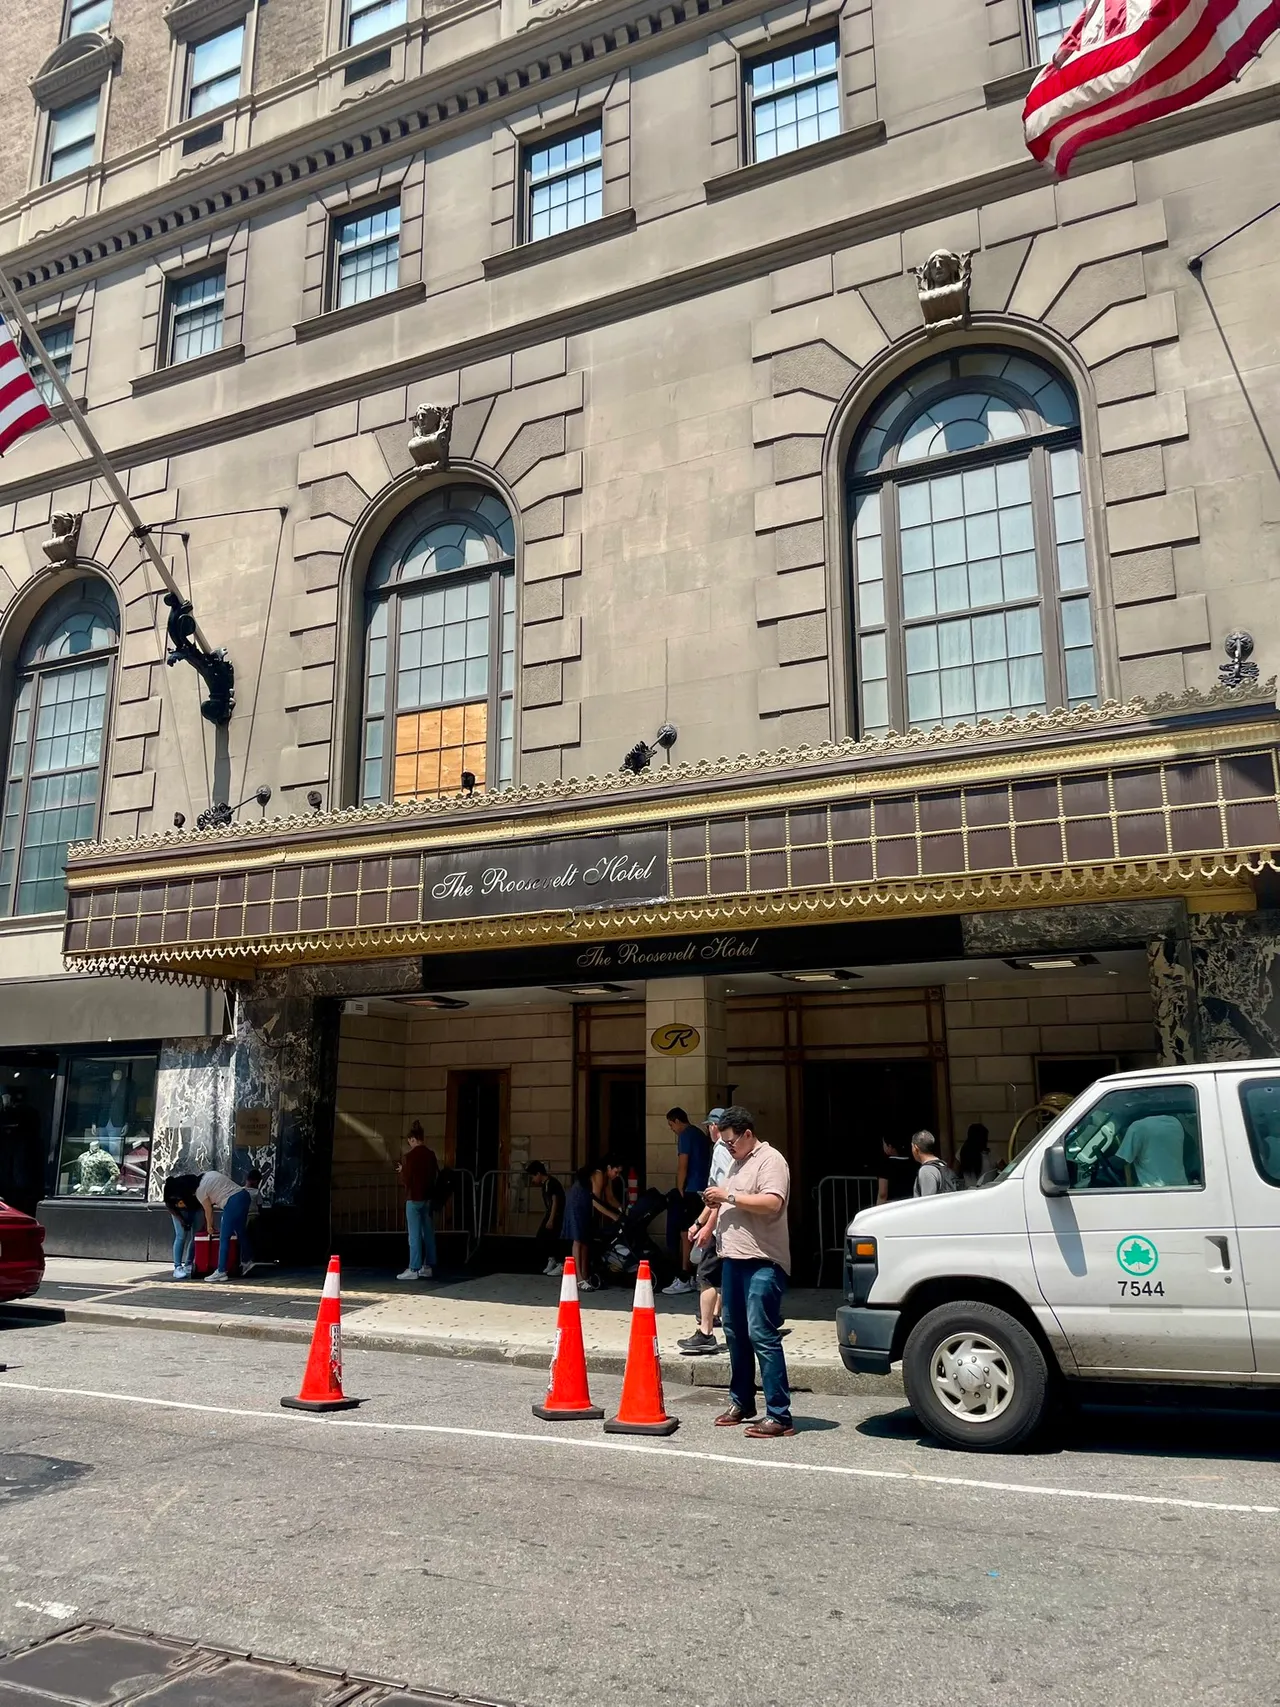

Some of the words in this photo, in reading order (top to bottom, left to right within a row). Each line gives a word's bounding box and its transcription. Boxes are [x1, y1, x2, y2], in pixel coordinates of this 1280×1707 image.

[431, 871, 473, 899] The
[582, 854, 657, 886] Hotel
[576, 945, 611, 968] The
[617, 941, 698, 965] Roosevelt
[700, 936, 760, 960] Hotel
[657, 1028, 694, 1050] R
[1117, 1280, 1165, 1297] 7544
